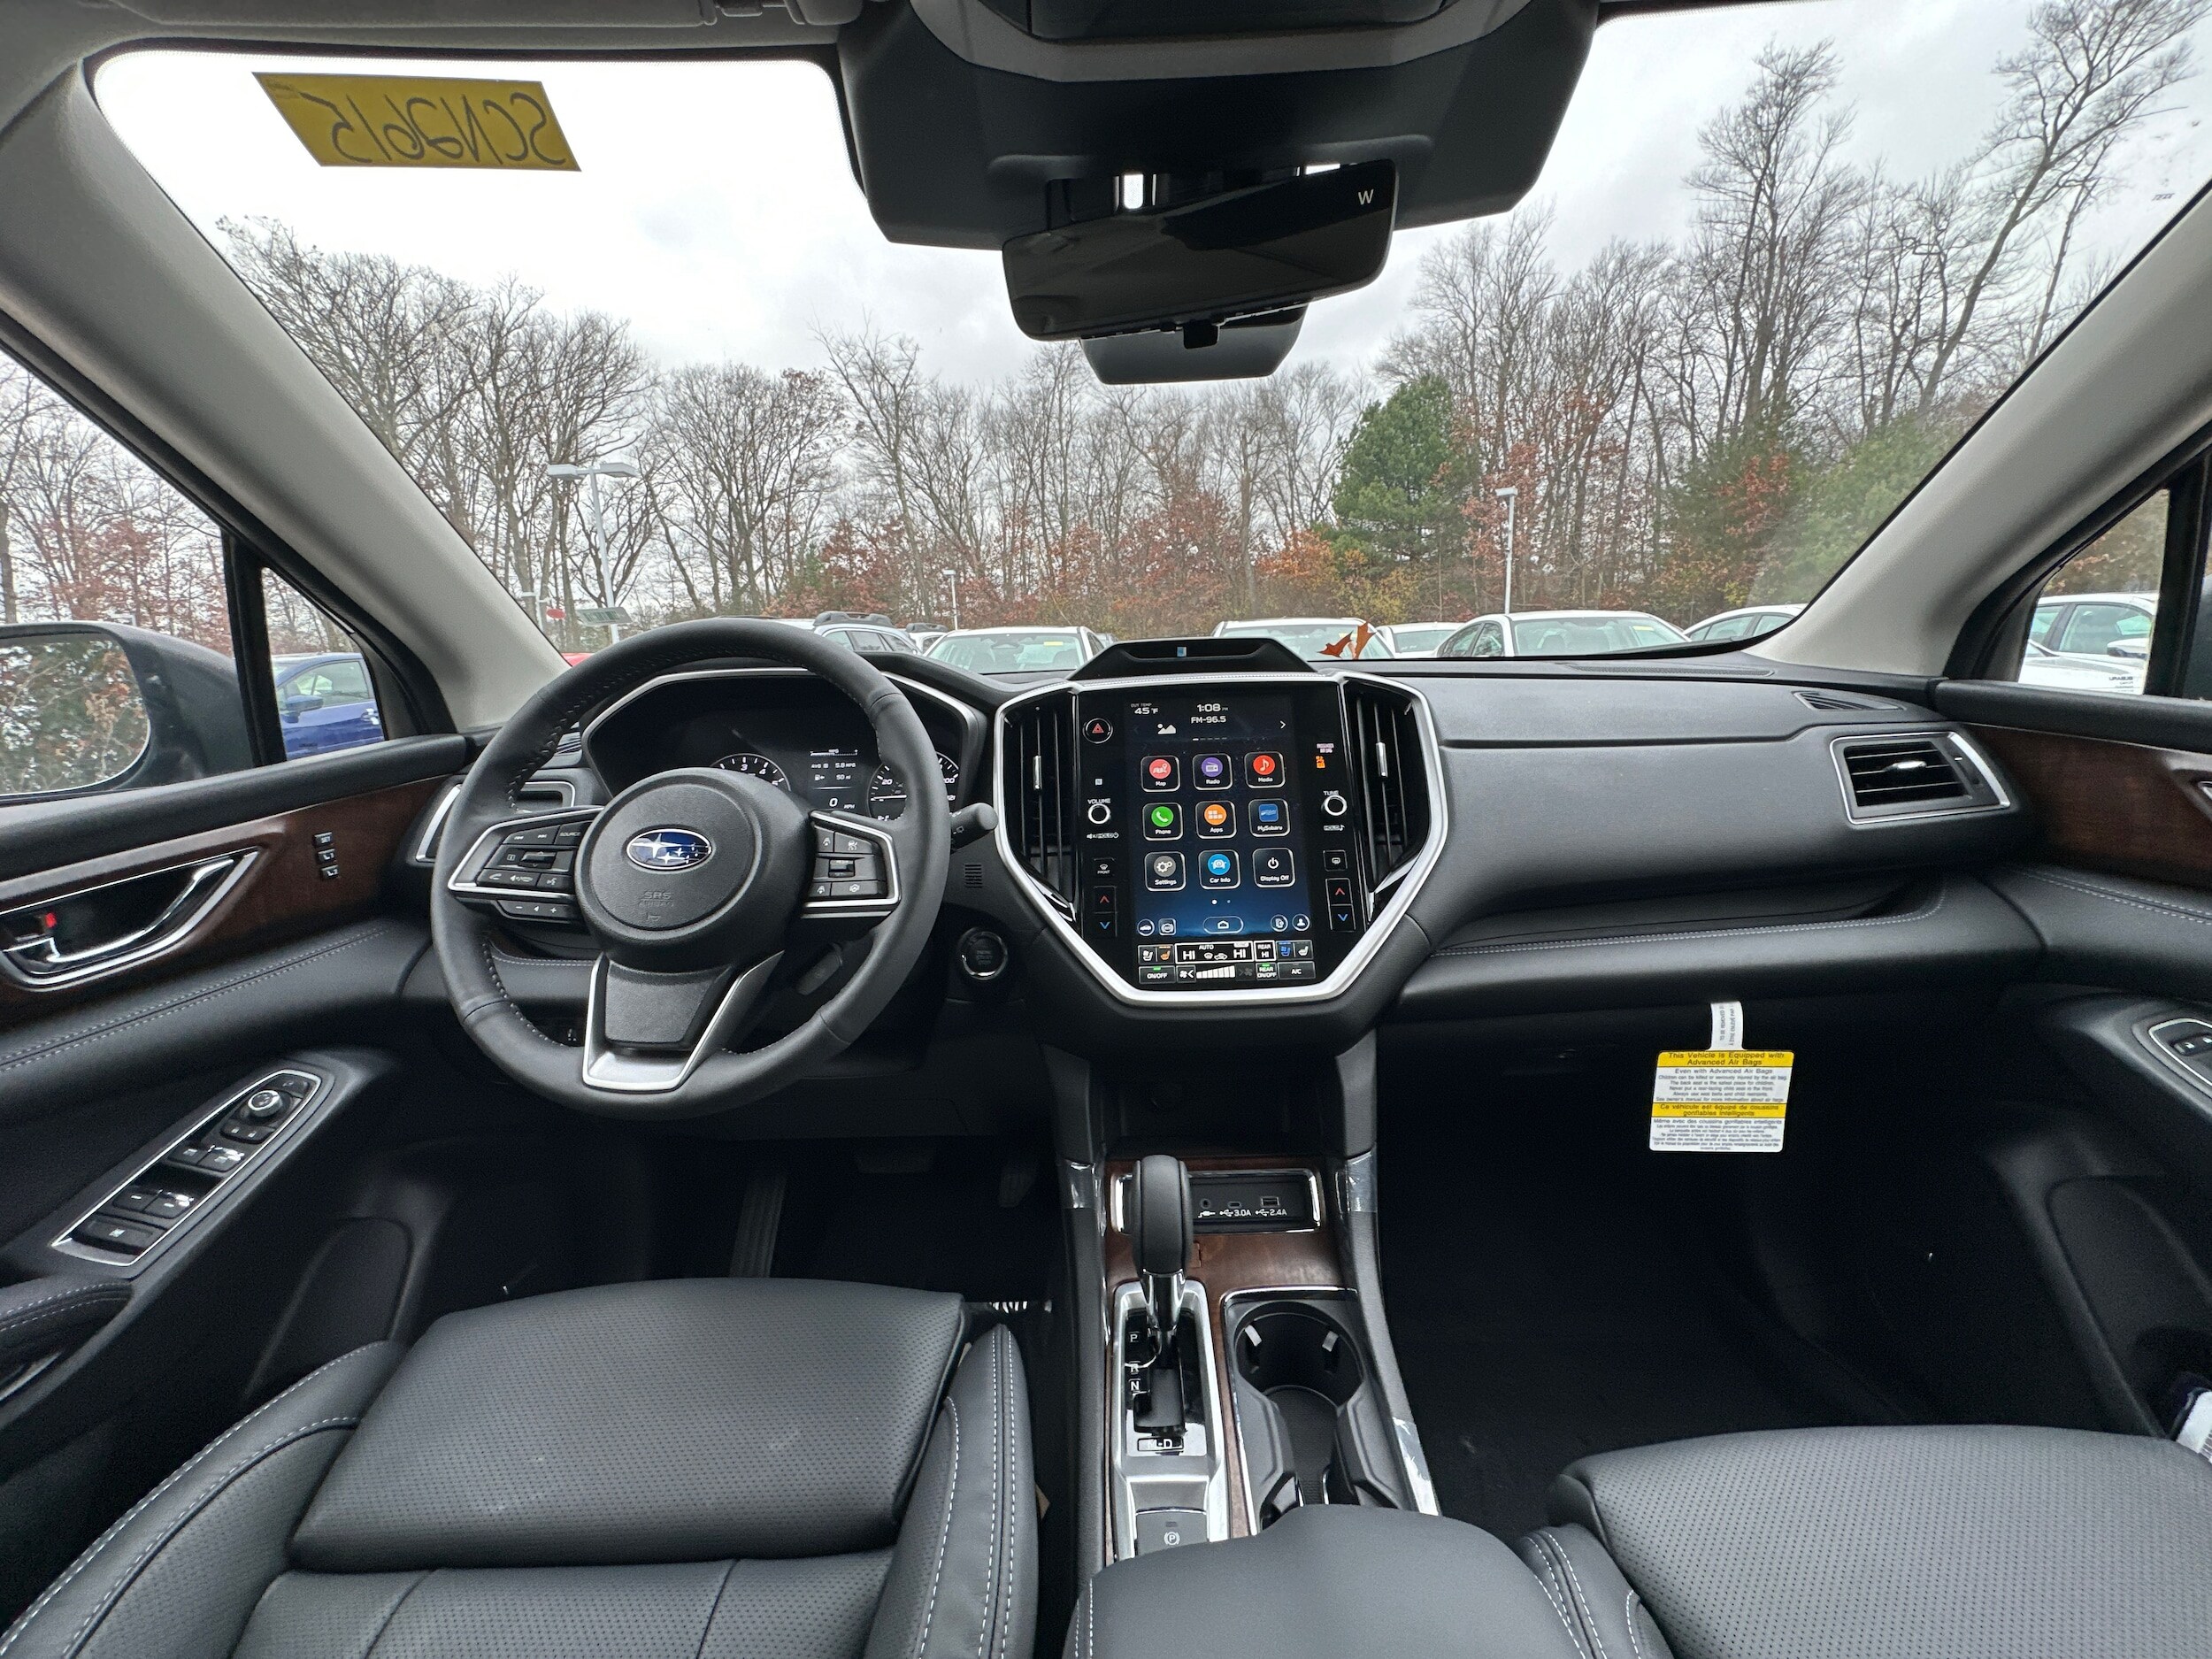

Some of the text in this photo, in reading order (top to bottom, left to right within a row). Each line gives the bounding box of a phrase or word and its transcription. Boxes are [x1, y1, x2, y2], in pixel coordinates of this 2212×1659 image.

[1357, 188, 1374, 205] W
[1196, 703, 1221, 712] 1:08
[829, 797, 838, 807] 0
[1182, 950, 1195, 960] HI
[1233, 949, 1247, 958] HI
[1130, 1333, 1138, 1342] P
[1131, 1380, 1140, 1390] N
